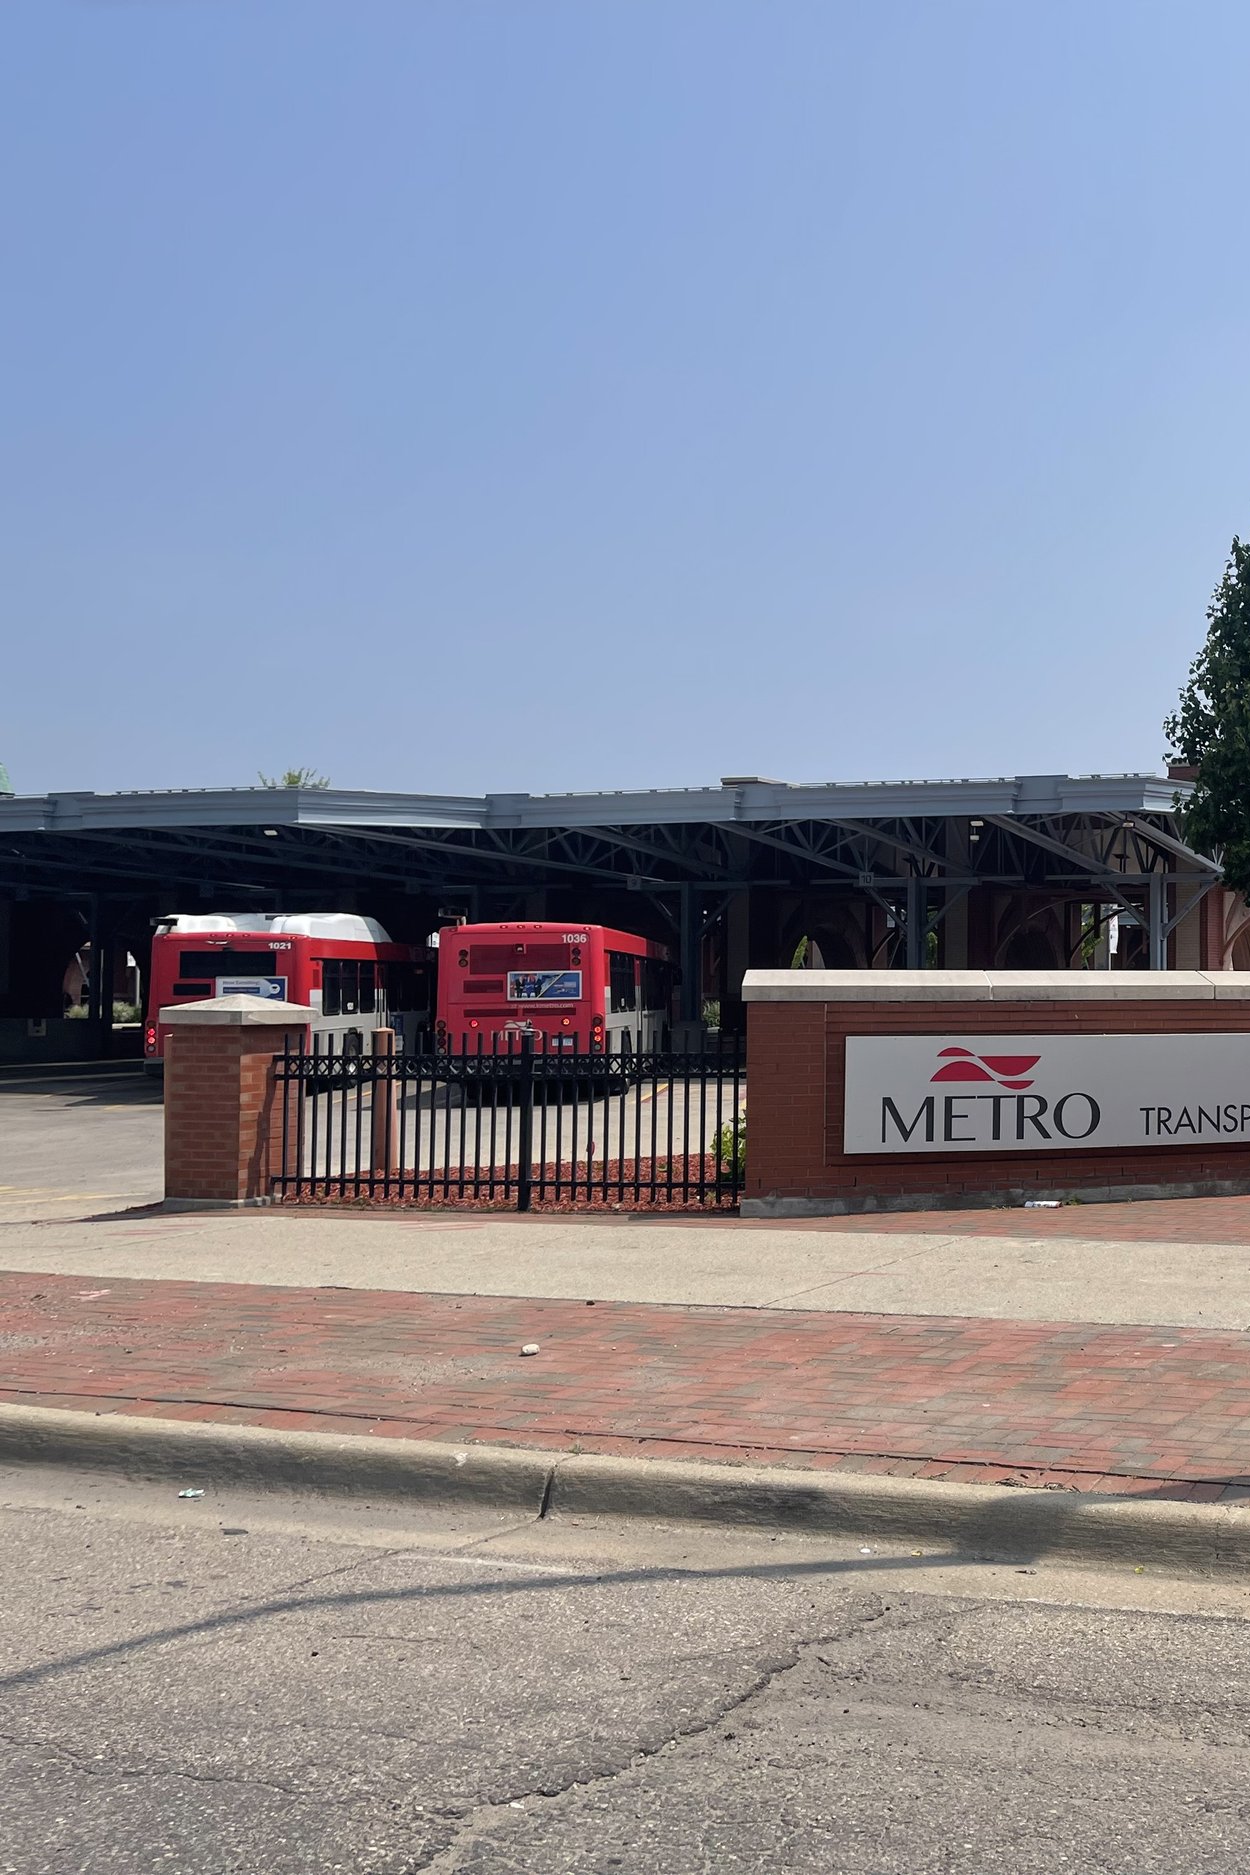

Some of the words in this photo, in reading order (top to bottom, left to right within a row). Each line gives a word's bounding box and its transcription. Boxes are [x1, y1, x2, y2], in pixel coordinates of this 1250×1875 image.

[861, 875, 872, 884] 10
[561, 933, 587, 943] 1036
[881, 1092, 1101, 1143] METRO
